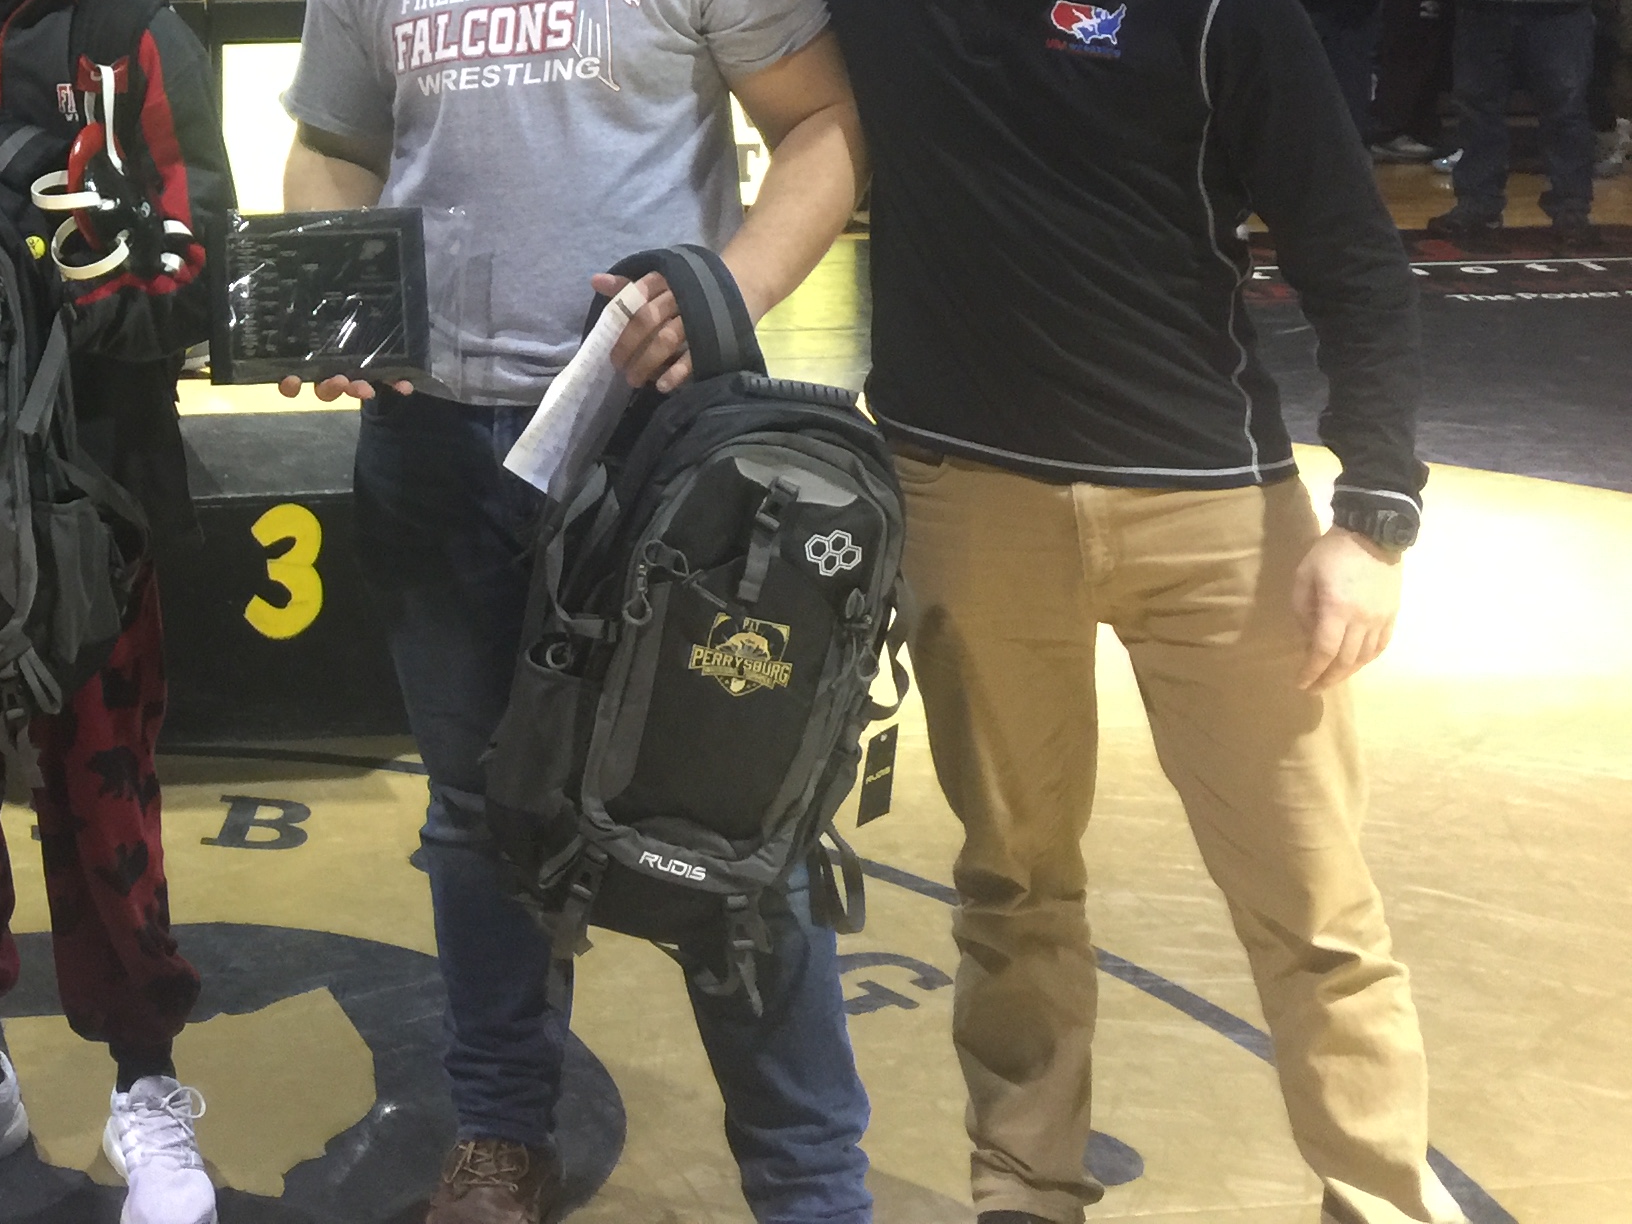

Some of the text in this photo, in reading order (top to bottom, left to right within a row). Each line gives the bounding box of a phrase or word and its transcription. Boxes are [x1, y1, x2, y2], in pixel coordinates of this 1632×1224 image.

[418, 56, 602, 97] WRESTLING
[243, 501, 324, 641] 3
[691, 647, 791, 684] PERRYSBURG
[638, 850, 707, 882] RUDIS
